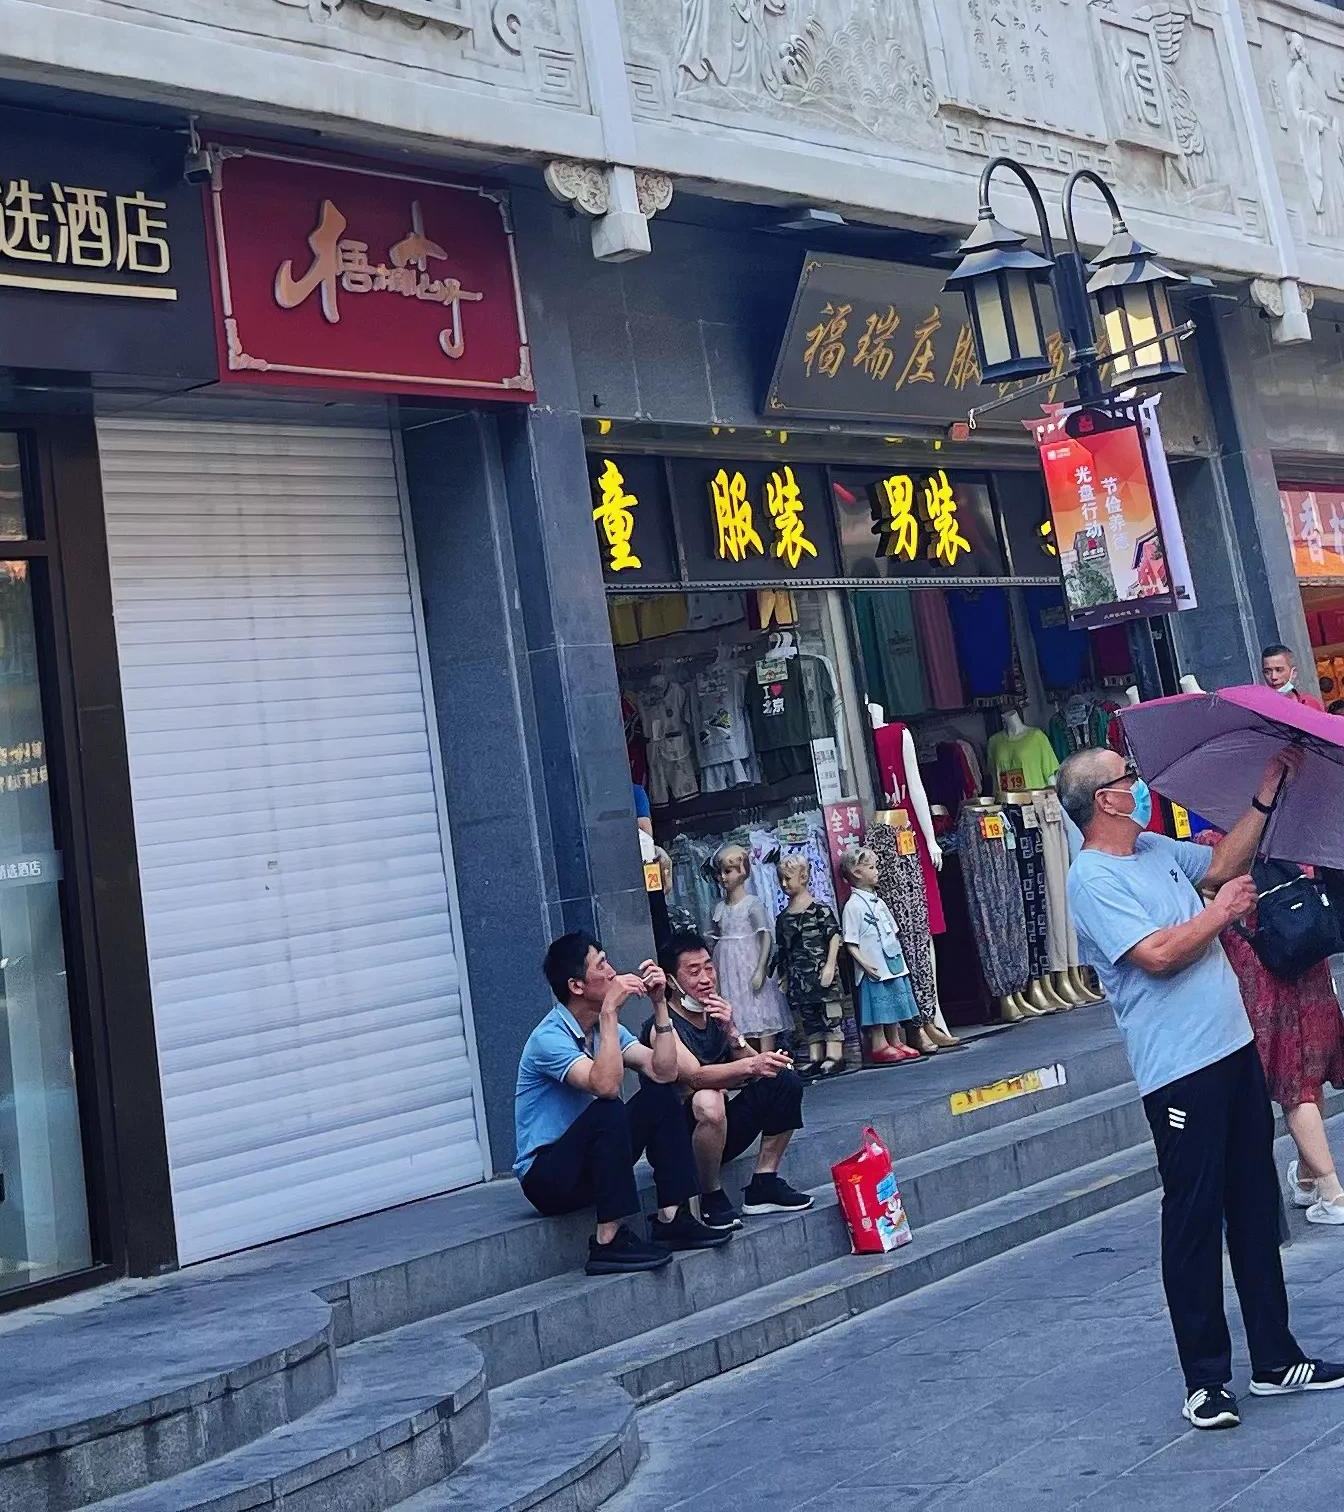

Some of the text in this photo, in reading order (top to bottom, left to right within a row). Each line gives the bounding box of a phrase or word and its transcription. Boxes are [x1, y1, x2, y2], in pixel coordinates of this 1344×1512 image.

[883, 469, 971, 567] 男装
[1074, 464, 1104, 539] 光盘行动
[1100, 477, 1129, 551] 节俭养德
